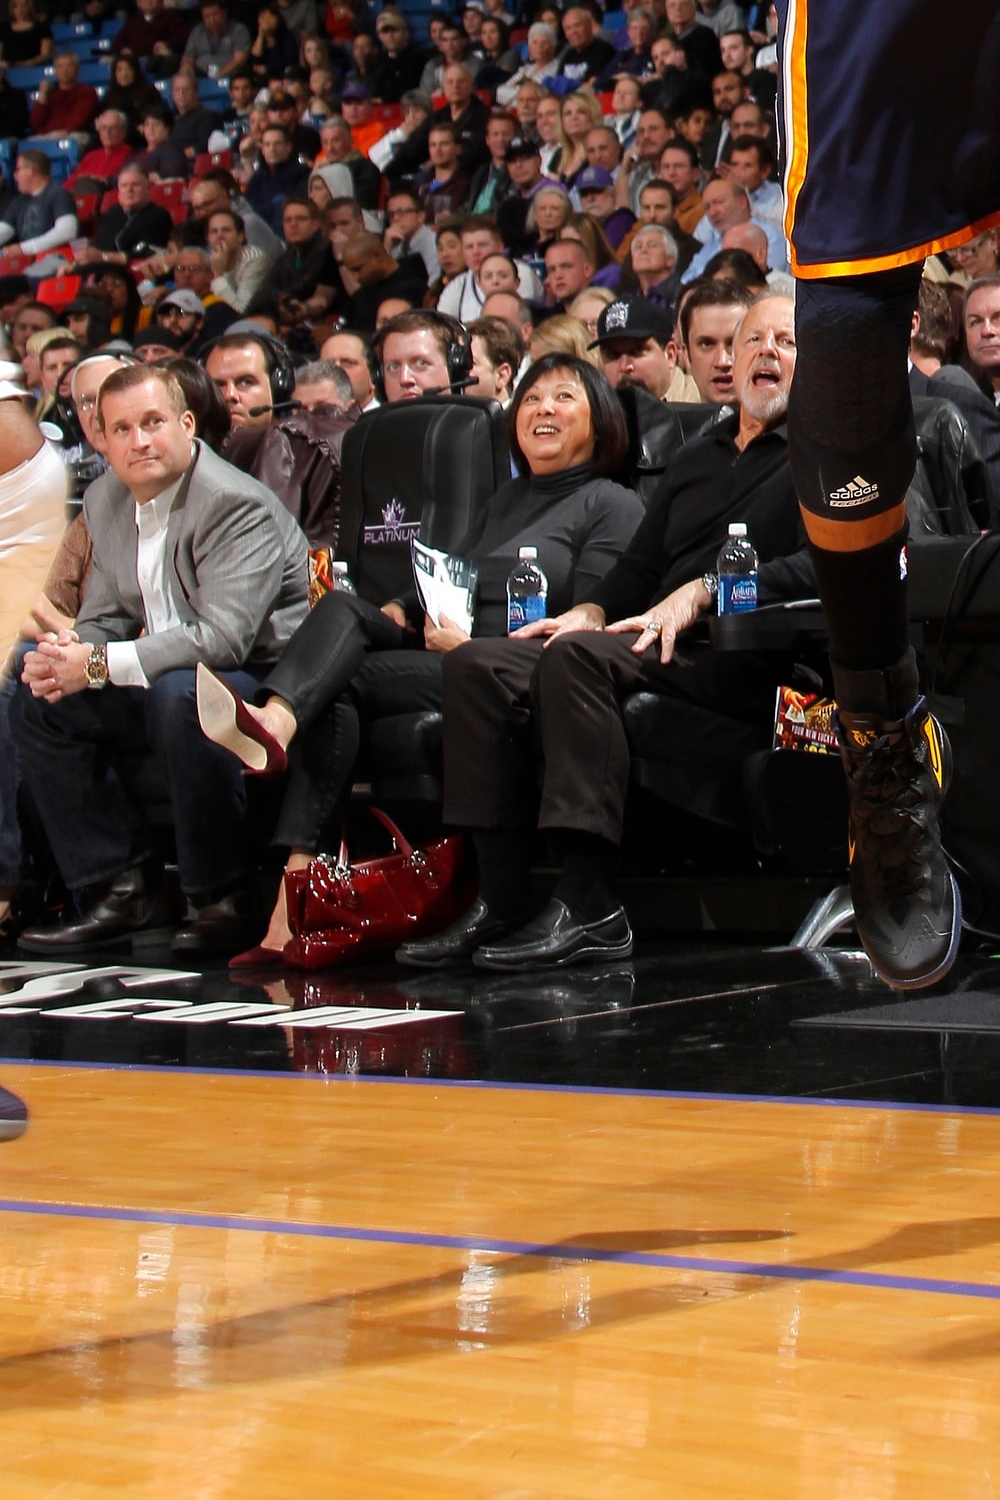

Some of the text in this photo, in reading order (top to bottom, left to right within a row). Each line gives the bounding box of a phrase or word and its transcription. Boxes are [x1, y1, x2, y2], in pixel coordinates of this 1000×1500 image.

[830, 483, 878, 500] adidas
[364, 528, 420, 545] PLATINUM
[791, 724, 805, 737] YOUR
[805, 728, 818, 740] NEW
[818, 731, 834, 745] LUCKY
